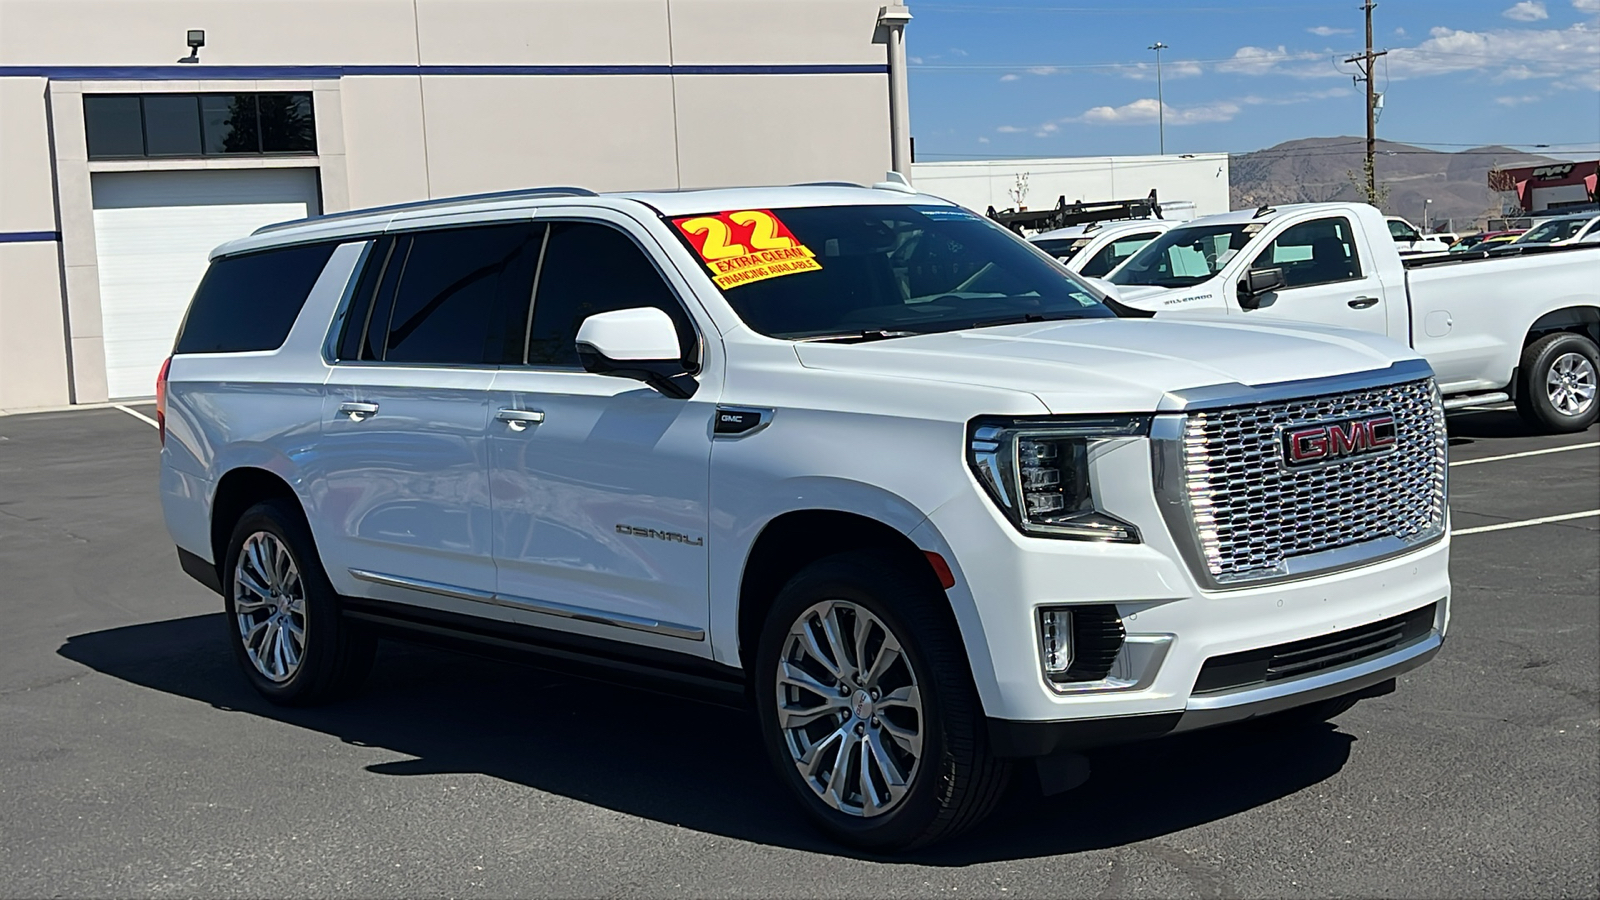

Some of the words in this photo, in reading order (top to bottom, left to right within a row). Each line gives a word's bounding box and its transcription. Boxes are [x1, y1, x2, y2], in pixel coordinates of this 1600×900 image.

[681, 211, 795, 259] 22
[715, 254, 761, 273] EXTRA
[717, 267, 768, 287] FINANCING
[767, 259, 816, 274] AVAILABLE
[1163, 294, 1213, 305] SILVERADO
[721, 414, 743, 423] GMC
[1291, 417, 1396, 462] GMC
[615, 523, 703, 547] DENALI
